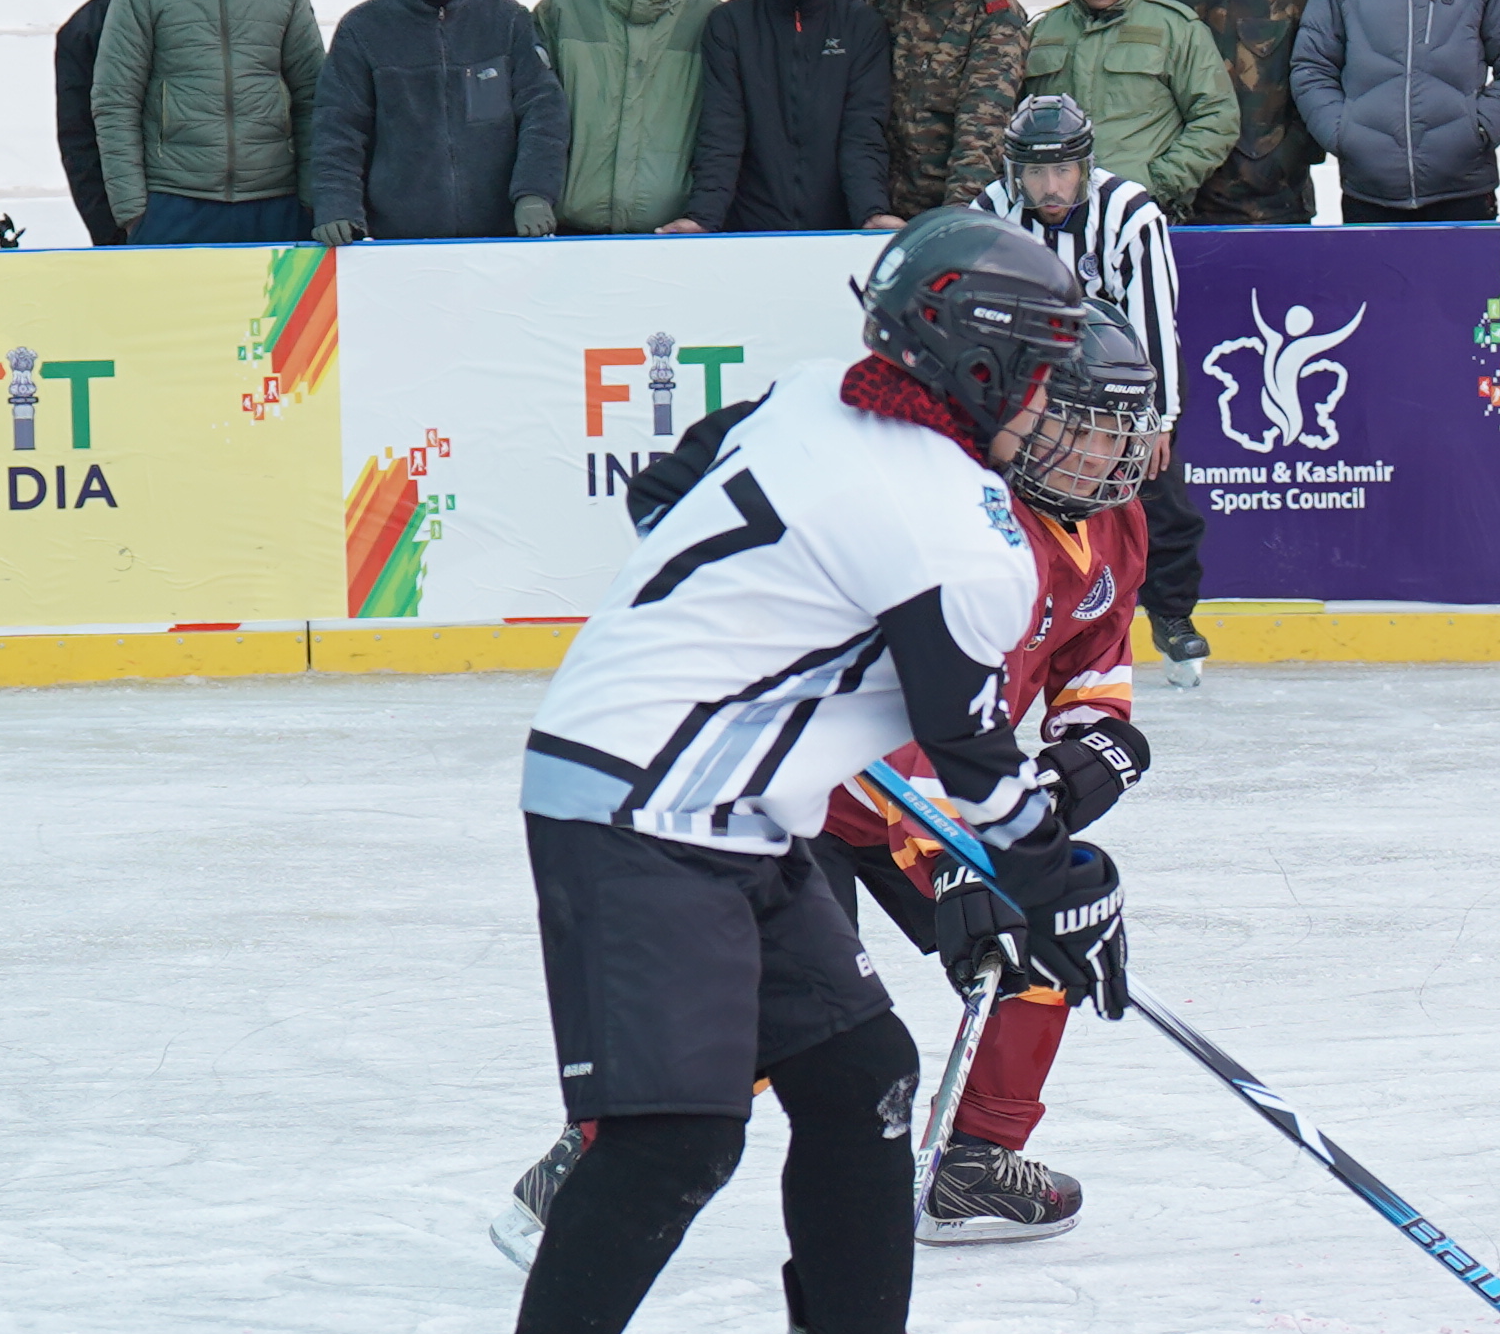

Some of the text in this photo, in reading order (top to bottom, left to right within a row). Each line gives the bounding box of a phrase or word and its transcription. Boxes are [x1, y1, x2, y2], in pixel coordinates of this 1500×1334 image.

[1272, 463, 1291, 483] &
[1296, 461, 1393, 483] Kashmir
[1211, 488, 1366, 514] Sports Council
